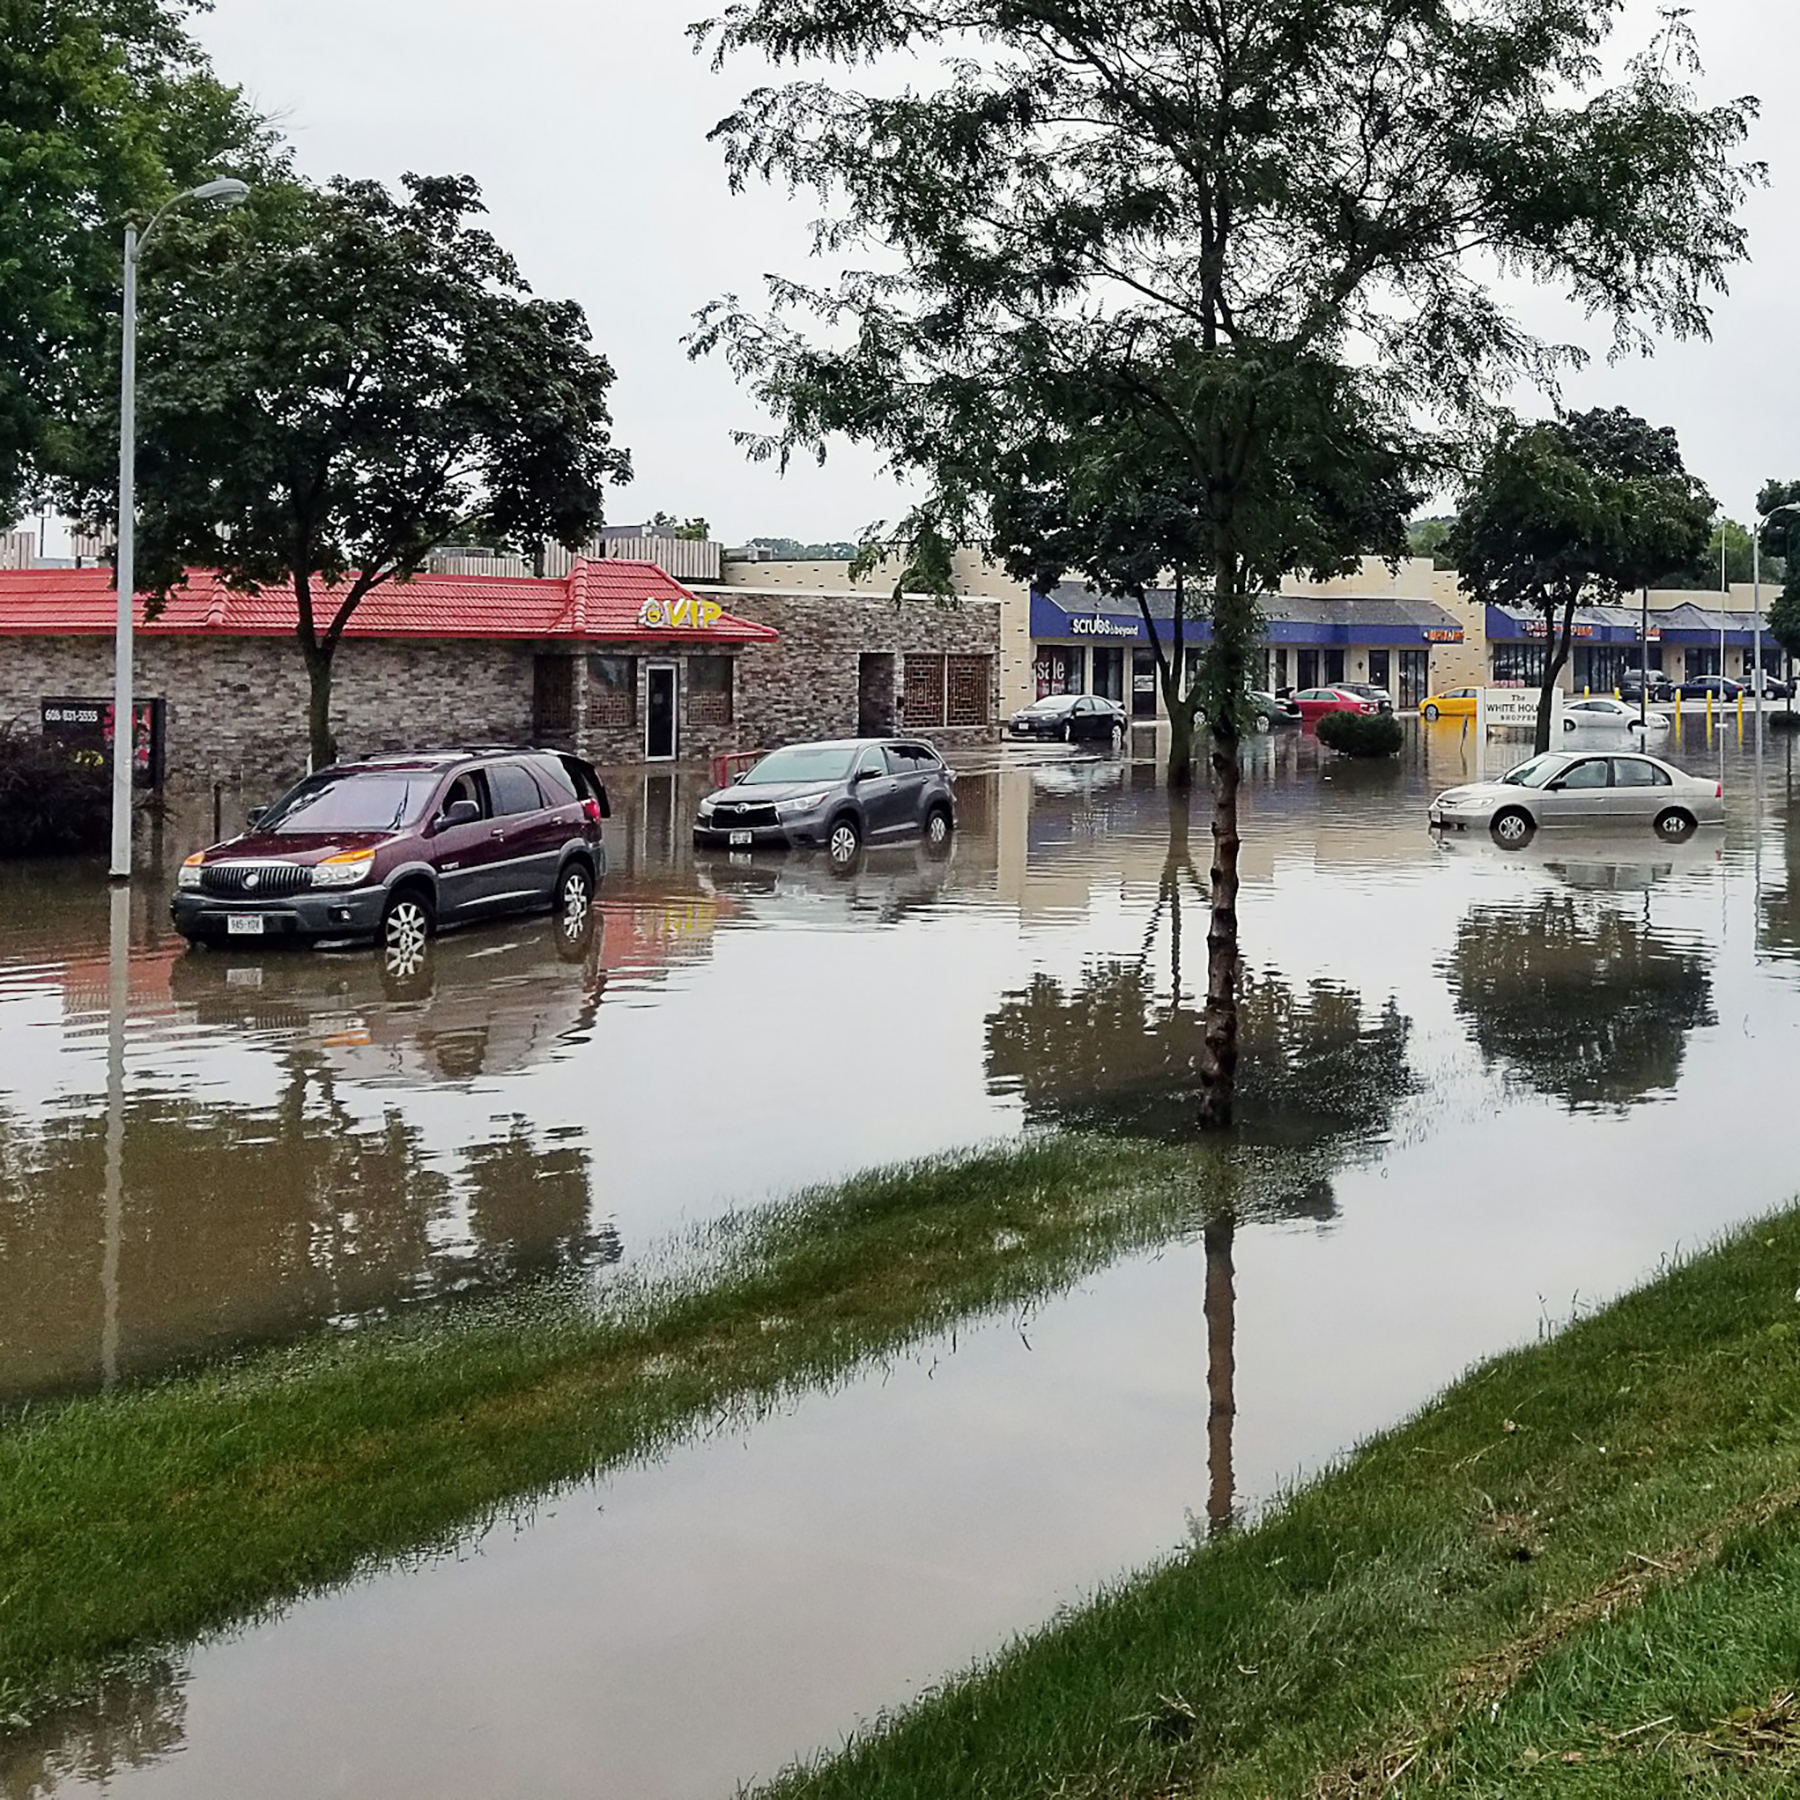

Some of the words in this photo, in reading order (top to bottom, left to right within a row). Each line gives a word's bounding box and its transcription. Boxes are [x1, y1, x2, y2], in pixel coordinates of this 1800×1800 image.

[663, 598, 722, 628] VIP
[1073, 614, 1110, 635] scrubs
[1511, 694, 1526, 702] The
[1486, 703, 1515, 712] WHITE
[1517, 703, 1539, 712] HOU
